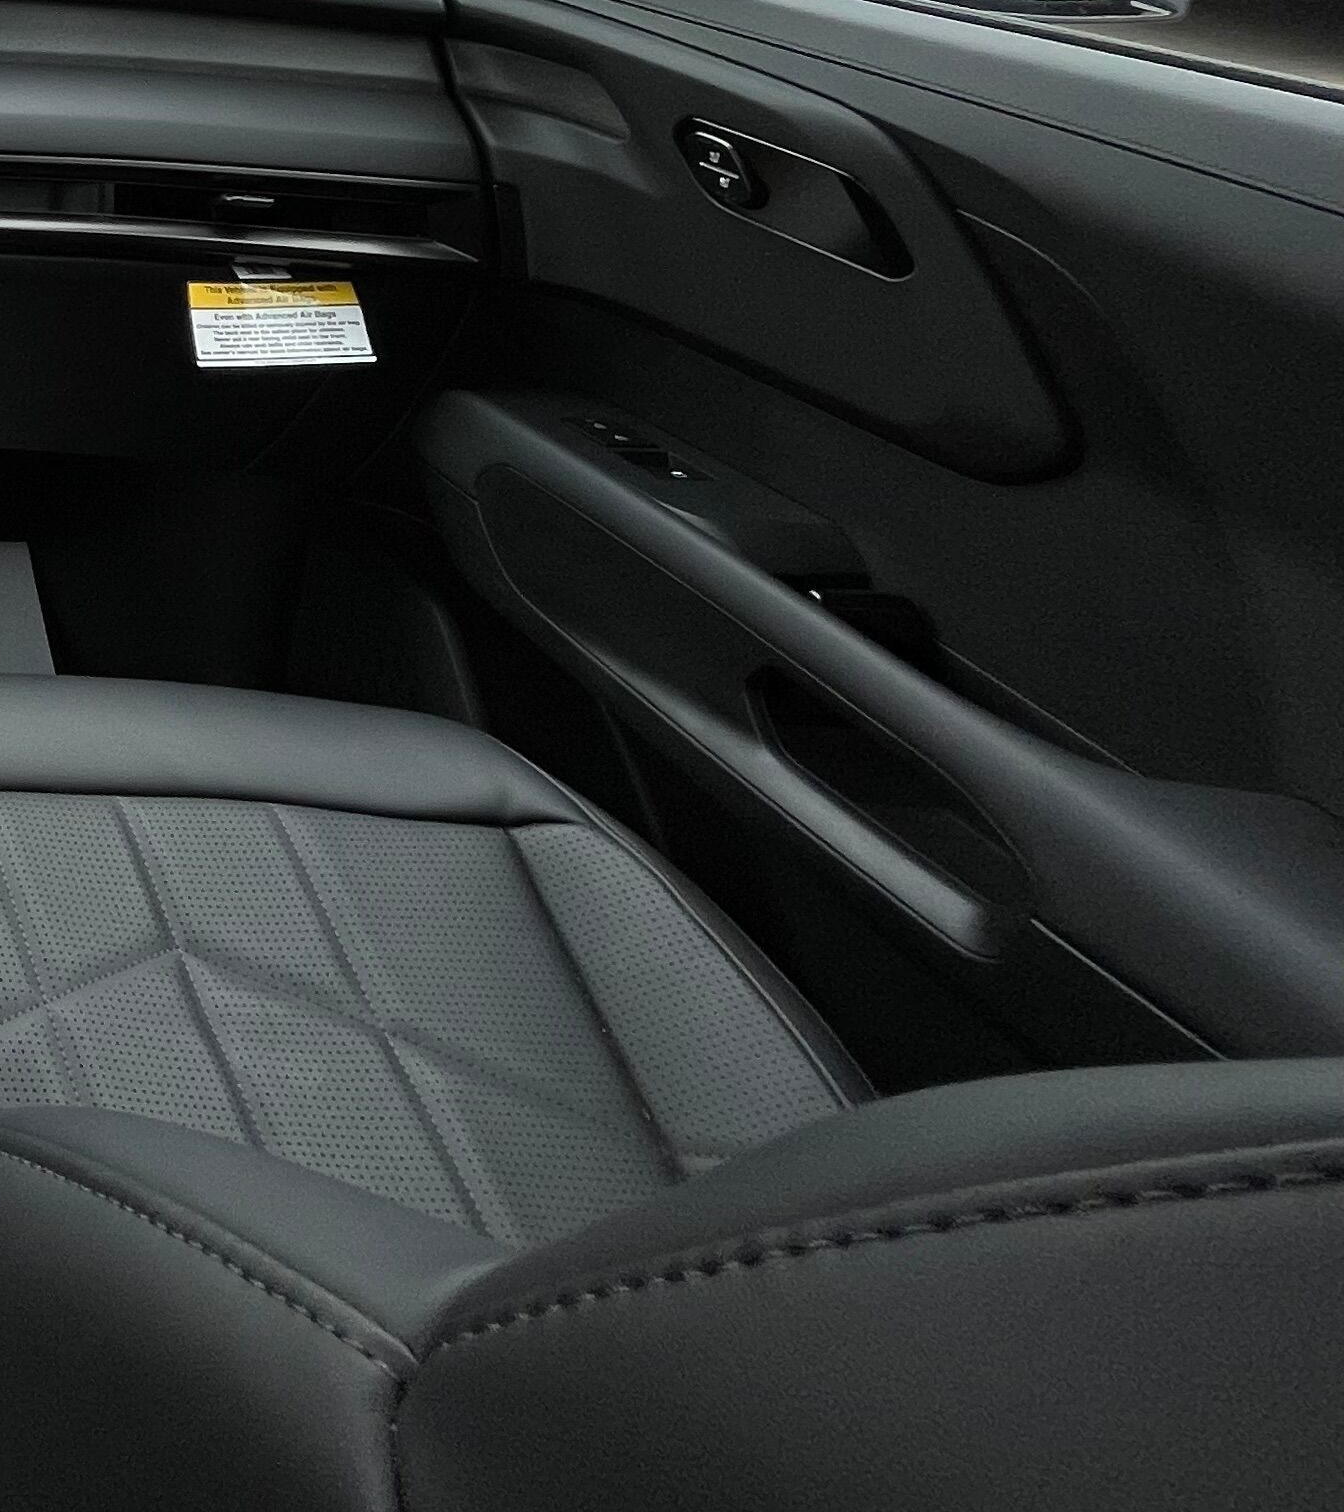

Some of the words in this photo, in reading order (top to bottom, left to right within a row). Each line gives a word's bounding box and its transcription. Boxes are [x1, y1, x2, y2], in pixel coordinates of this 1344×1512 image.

[214, 313, 235, 321] Even
[255, 310, 298, 321] Advanced
[300, 310, 313, 319] Air
[314, 310, 337, 320] Bags
